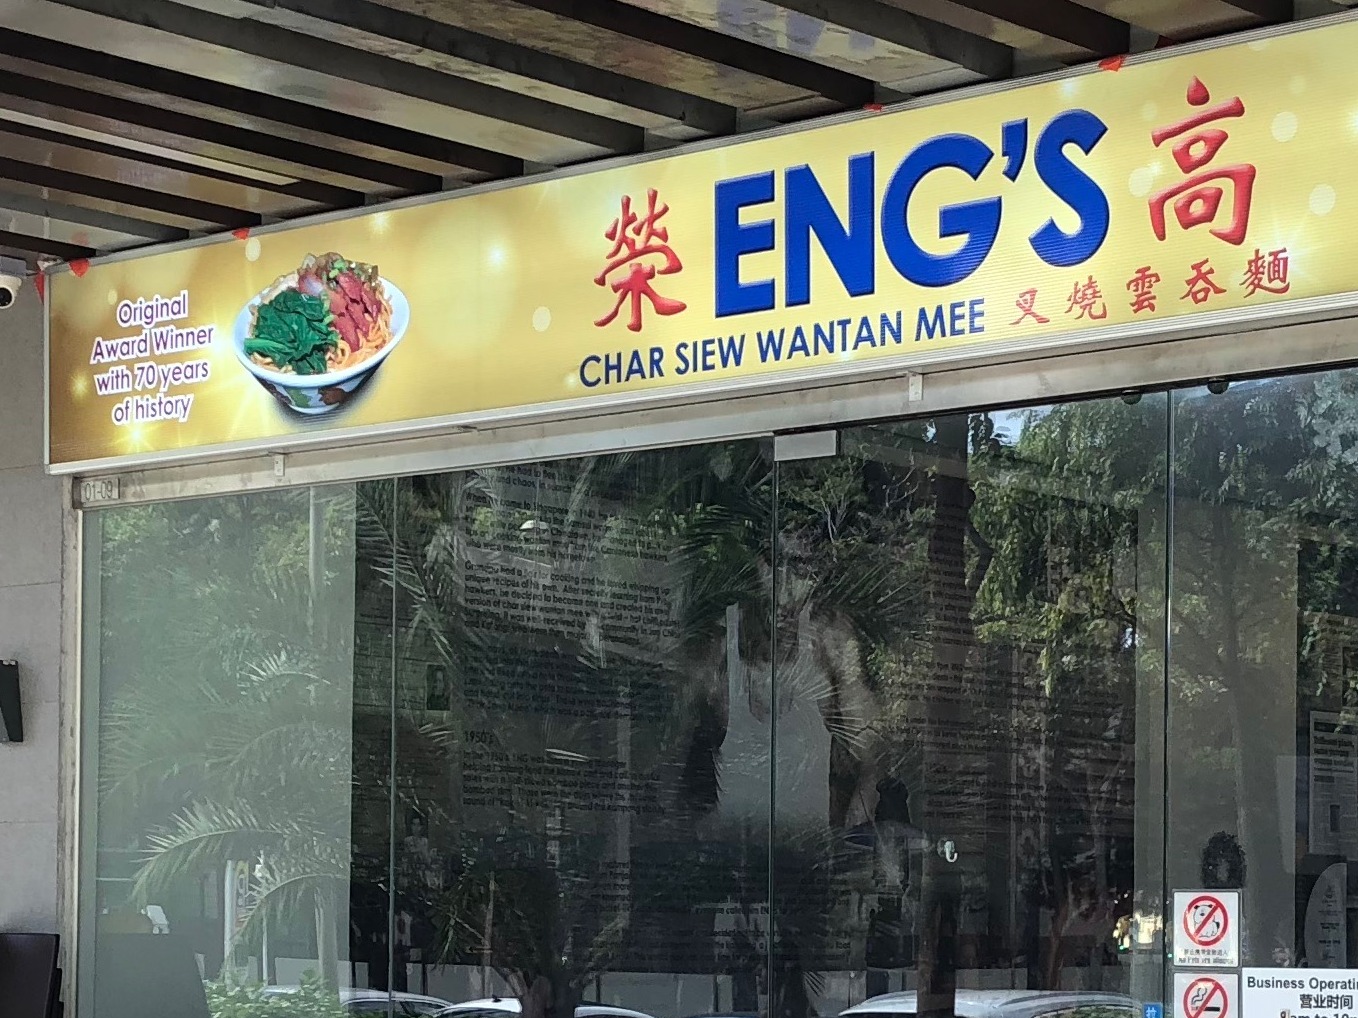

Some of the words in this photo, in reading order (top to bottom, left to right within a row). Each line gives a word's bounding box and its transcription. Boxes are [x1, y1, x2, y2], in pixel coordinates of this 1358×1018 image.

[1148, 75, 1256, 246] 高
[715, 108, 1111, 319] ENG'S
[119, 293, 186, 325] Original
[93, 333, 148, 360] Award
[154, 327, 214, 351] Winner
[579, 347, 664, 388] CHAR
[675, 334, 745, 375] SIEW
[756, 310, 902, 363] WANTAN
[914, 298, 985, 341] MEE
[97, 369, 130, 392] with
[136, 364, 155, 387] 70
[161, 362, 208, 389] years
[114, 401, 130, 422] of
[135, 397, 191, 419] history
[85, 481, 112, 500] 01-09
[1247, 977, 1305, 989] Business
[1299, 994, 1353, 1009] 营业时间
